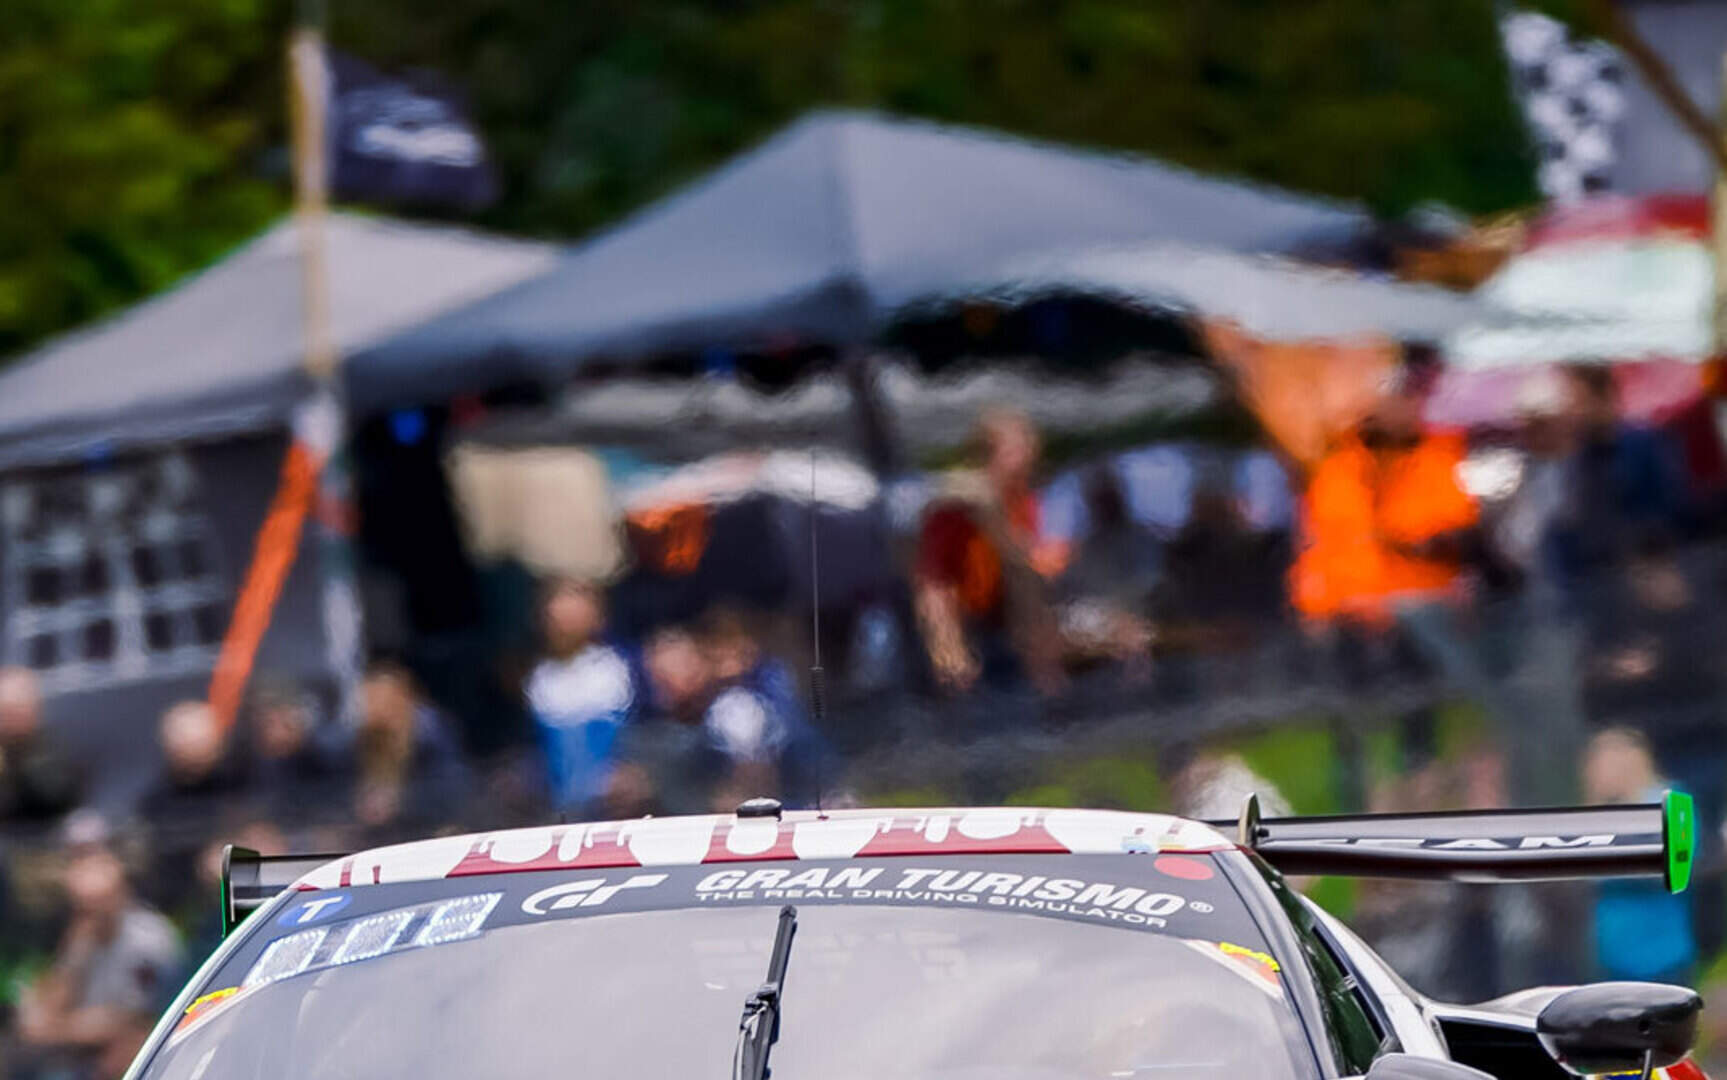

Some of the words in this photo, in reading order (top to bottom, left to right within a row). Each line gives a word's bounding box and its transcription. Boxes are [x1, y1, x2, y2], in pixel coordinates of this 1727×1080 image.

[696, 868, 886, 892] GRAN
[895, 867, 1187, 916] TURISMO
[696, 889, 754, 901] THE
[763, 889, 843, 899] REAL
[852, 888, 979, 903] DRIVING
[987, 894, 1168, 928] SIMULATOR
